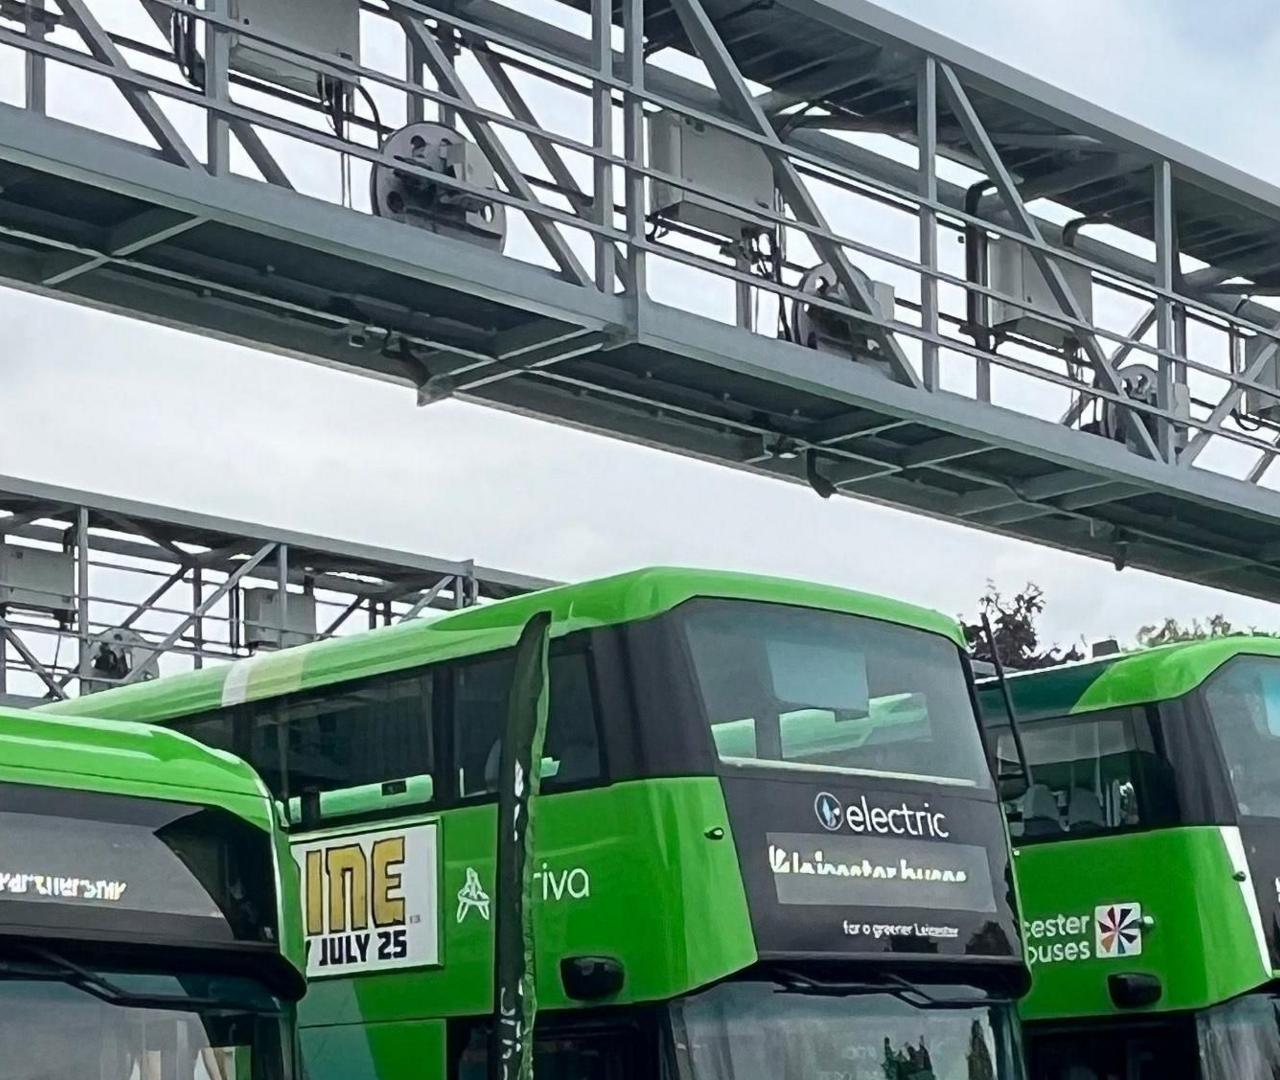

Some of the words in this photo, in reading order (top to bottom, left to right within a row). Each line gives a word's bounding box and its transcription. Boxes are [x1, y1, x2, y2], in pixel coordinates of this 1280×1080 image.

[846, 795, 949, 838] electric
[319, 933, 370, 966] JULY
[377, 930, 407, 960] 25
